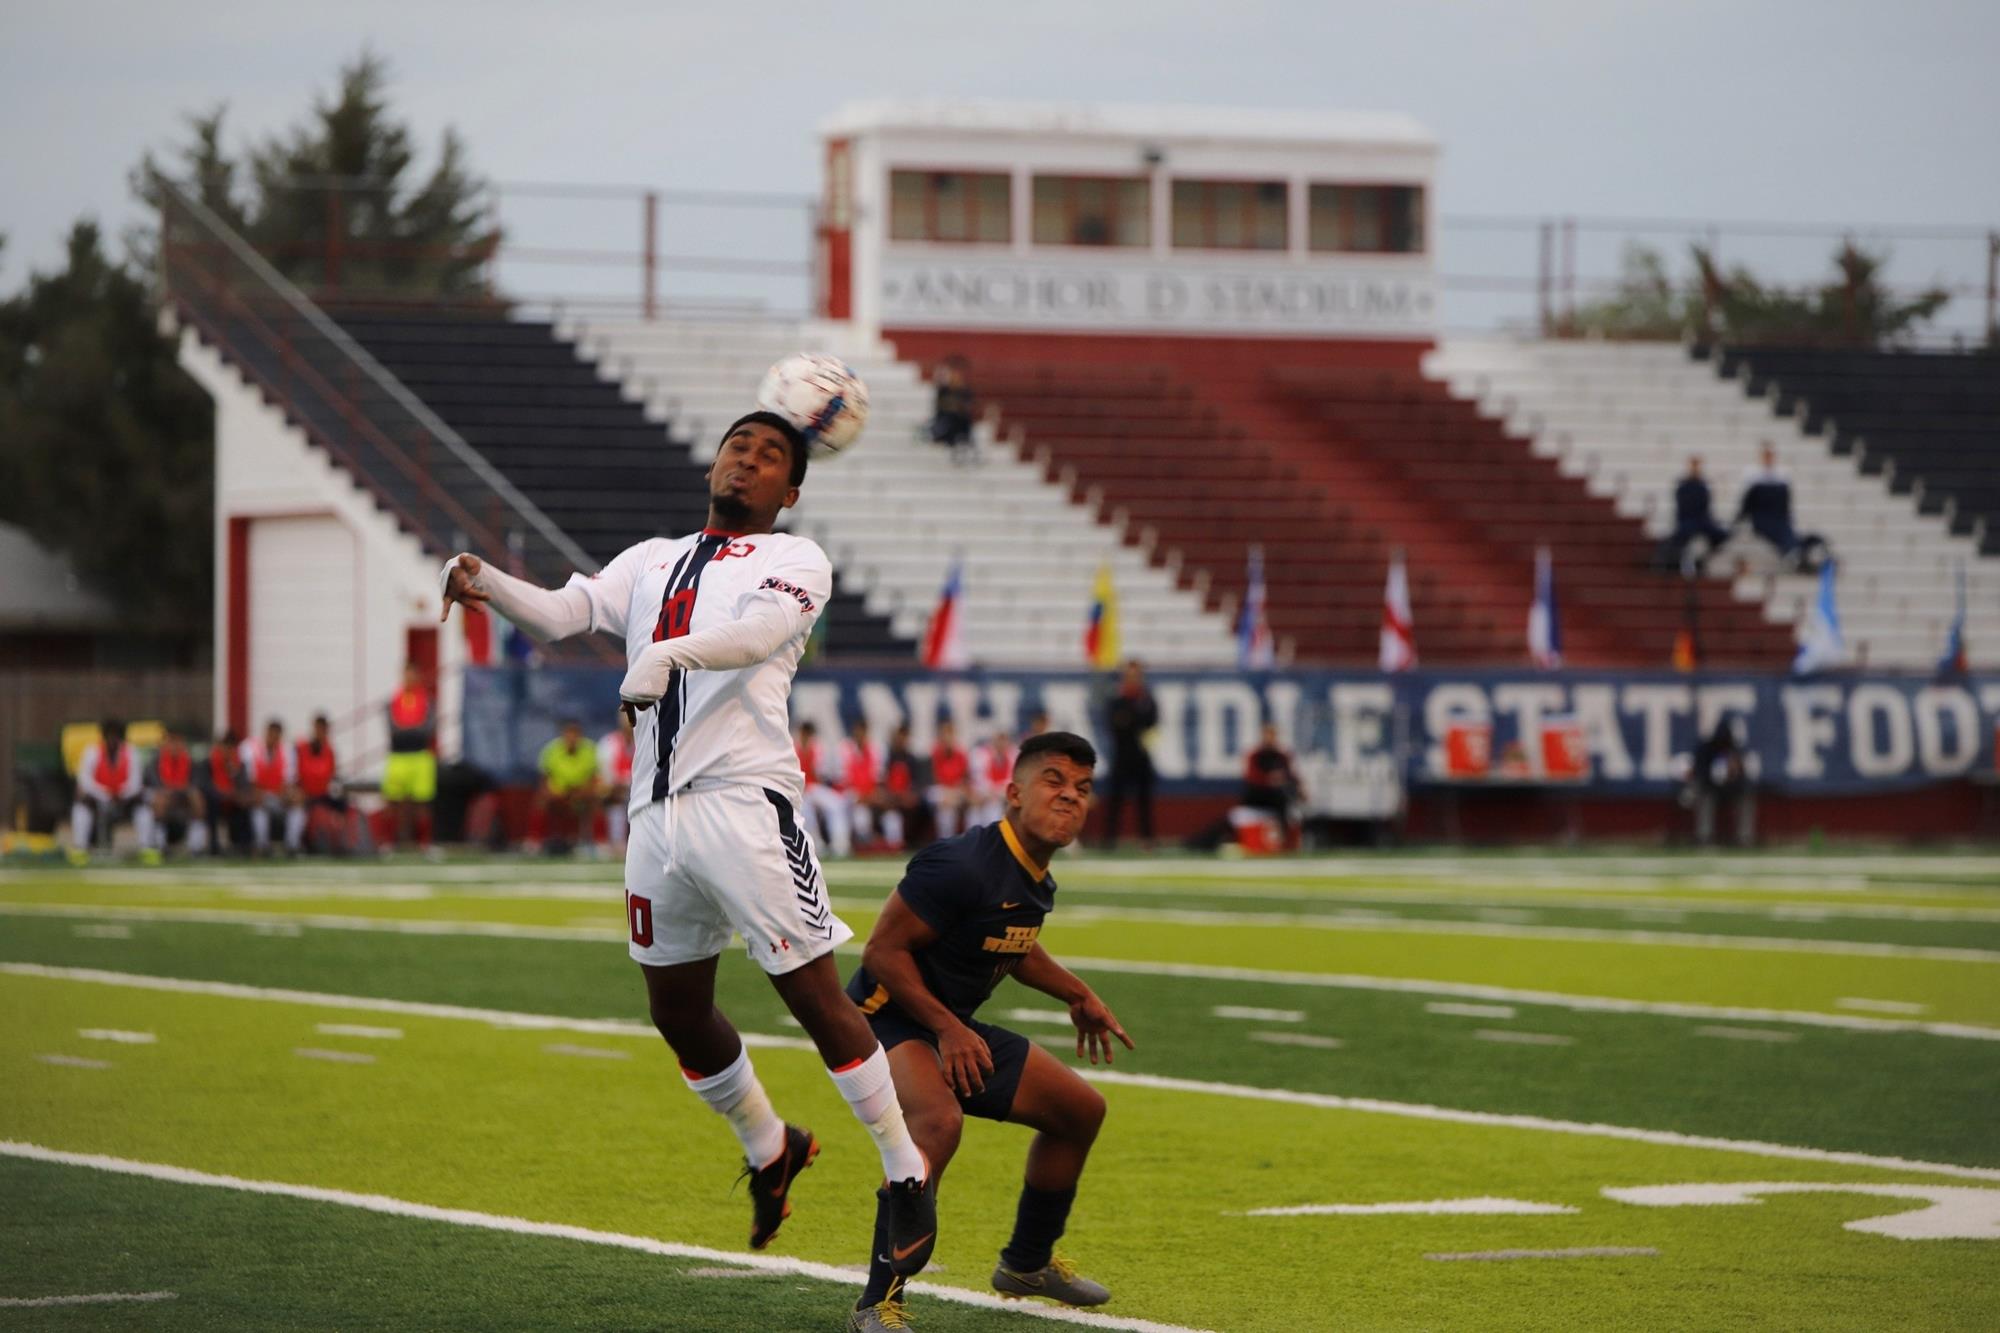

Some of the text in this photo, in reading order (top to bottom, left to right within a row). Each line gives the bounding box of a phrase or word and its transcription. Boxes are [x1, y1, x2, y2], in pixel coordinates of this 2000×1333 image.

[902, 271, 1411, 321] ANCHOR D STADIUM
[1424, 682, 1758, 781] STATE
